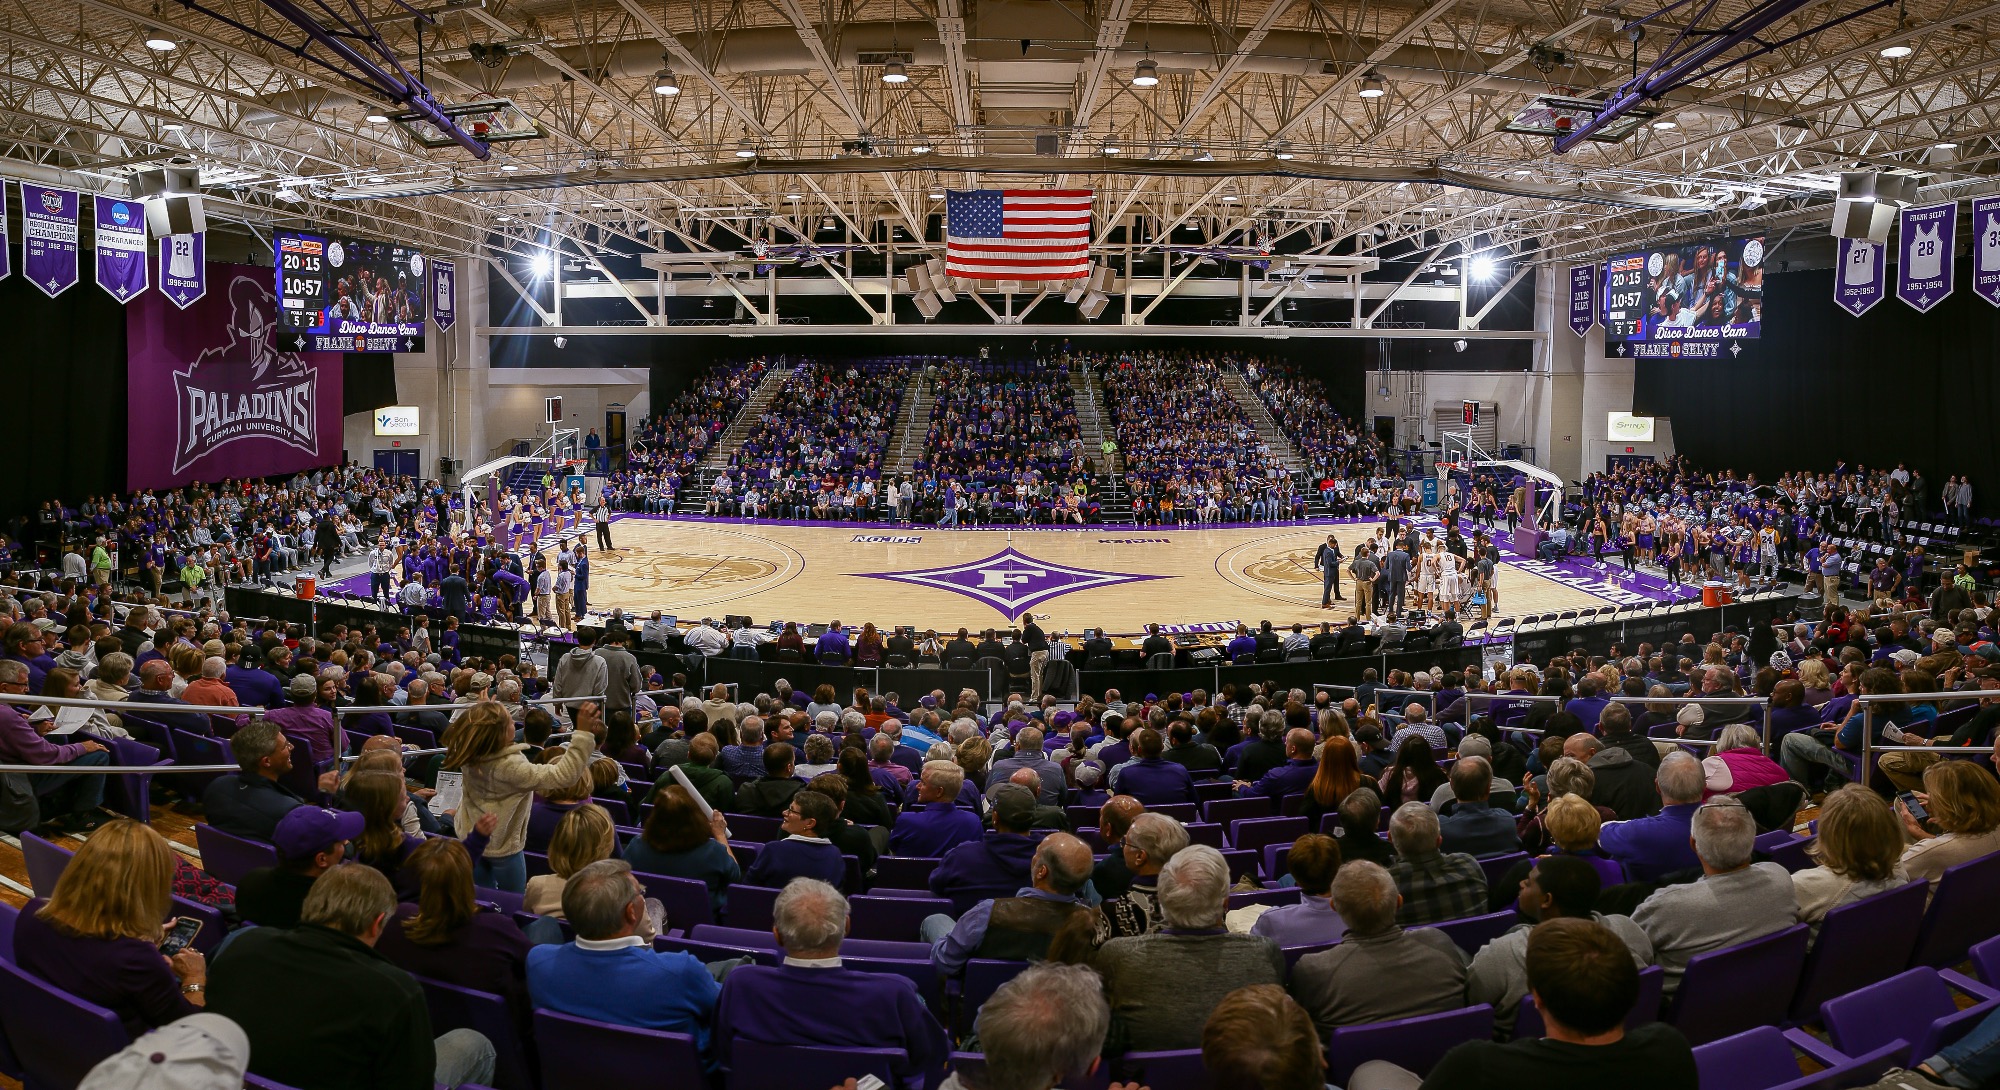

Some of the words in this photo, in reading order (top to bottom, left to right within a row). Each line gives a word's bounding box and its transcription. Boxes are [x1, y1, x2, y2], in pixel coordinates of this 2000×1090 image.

[113, 212, 129, 221] NCAA
[1909, 212, 1928, 222] FRANK
[29, 220, 55, 230] REGULAR
[56, 224, 76, 233] SEASON
[29, 228, 76, 242] CHAMPIONS
[97, 234, 144, 246] APPEARANCES
[1989, 230, 2000, 247] 3
[175, 240, 189, 257] 22
[1853, 248, 1868, 265] 27
[1917, 240, 1935, 257] 28
[284, 254, 300, 270] 20
[305, 256, 320, 272] 15
[284, 277, 322, 297] 10:57
[1612, 273, 1625, 287] 20
[1629, 271, 1641, 285] 15
[1611, 291, 1641, 309] 10:57
[294, 316, 300, 327] 5
[308, 316, 315, 327] 2
[338, 320, 367, 334] Disco
[368, 321, 398, 335] Dance
[398, 322, 418, 336] Cam
[1616, 325, 1622, 335] 5
[1628, 325, 1634, 335] 2
[1654, 326, 1683, 340] Disco
[1684, 325, 1720, 339] Dance
[1720, 323, 1748, 338] Cam
[315, 335, 355, 351] FRANK
[366, 337, 398, 351] SELVY
[1633, 342, 1670, 357] FRANK
[1681, 342, 1720, 357] SELVY
[184, 380, 311, 455] PALADINS
[389, 420, 418, 428] Secours
[206, 423, 242, 447] FURMAN
[246, 422, 292, 438] UNIVERSITY
[1761, 535, 1773, 545] 24
[976, 570, 1047, 588] F
[1507, 558, 1660, 606] PALADIN
